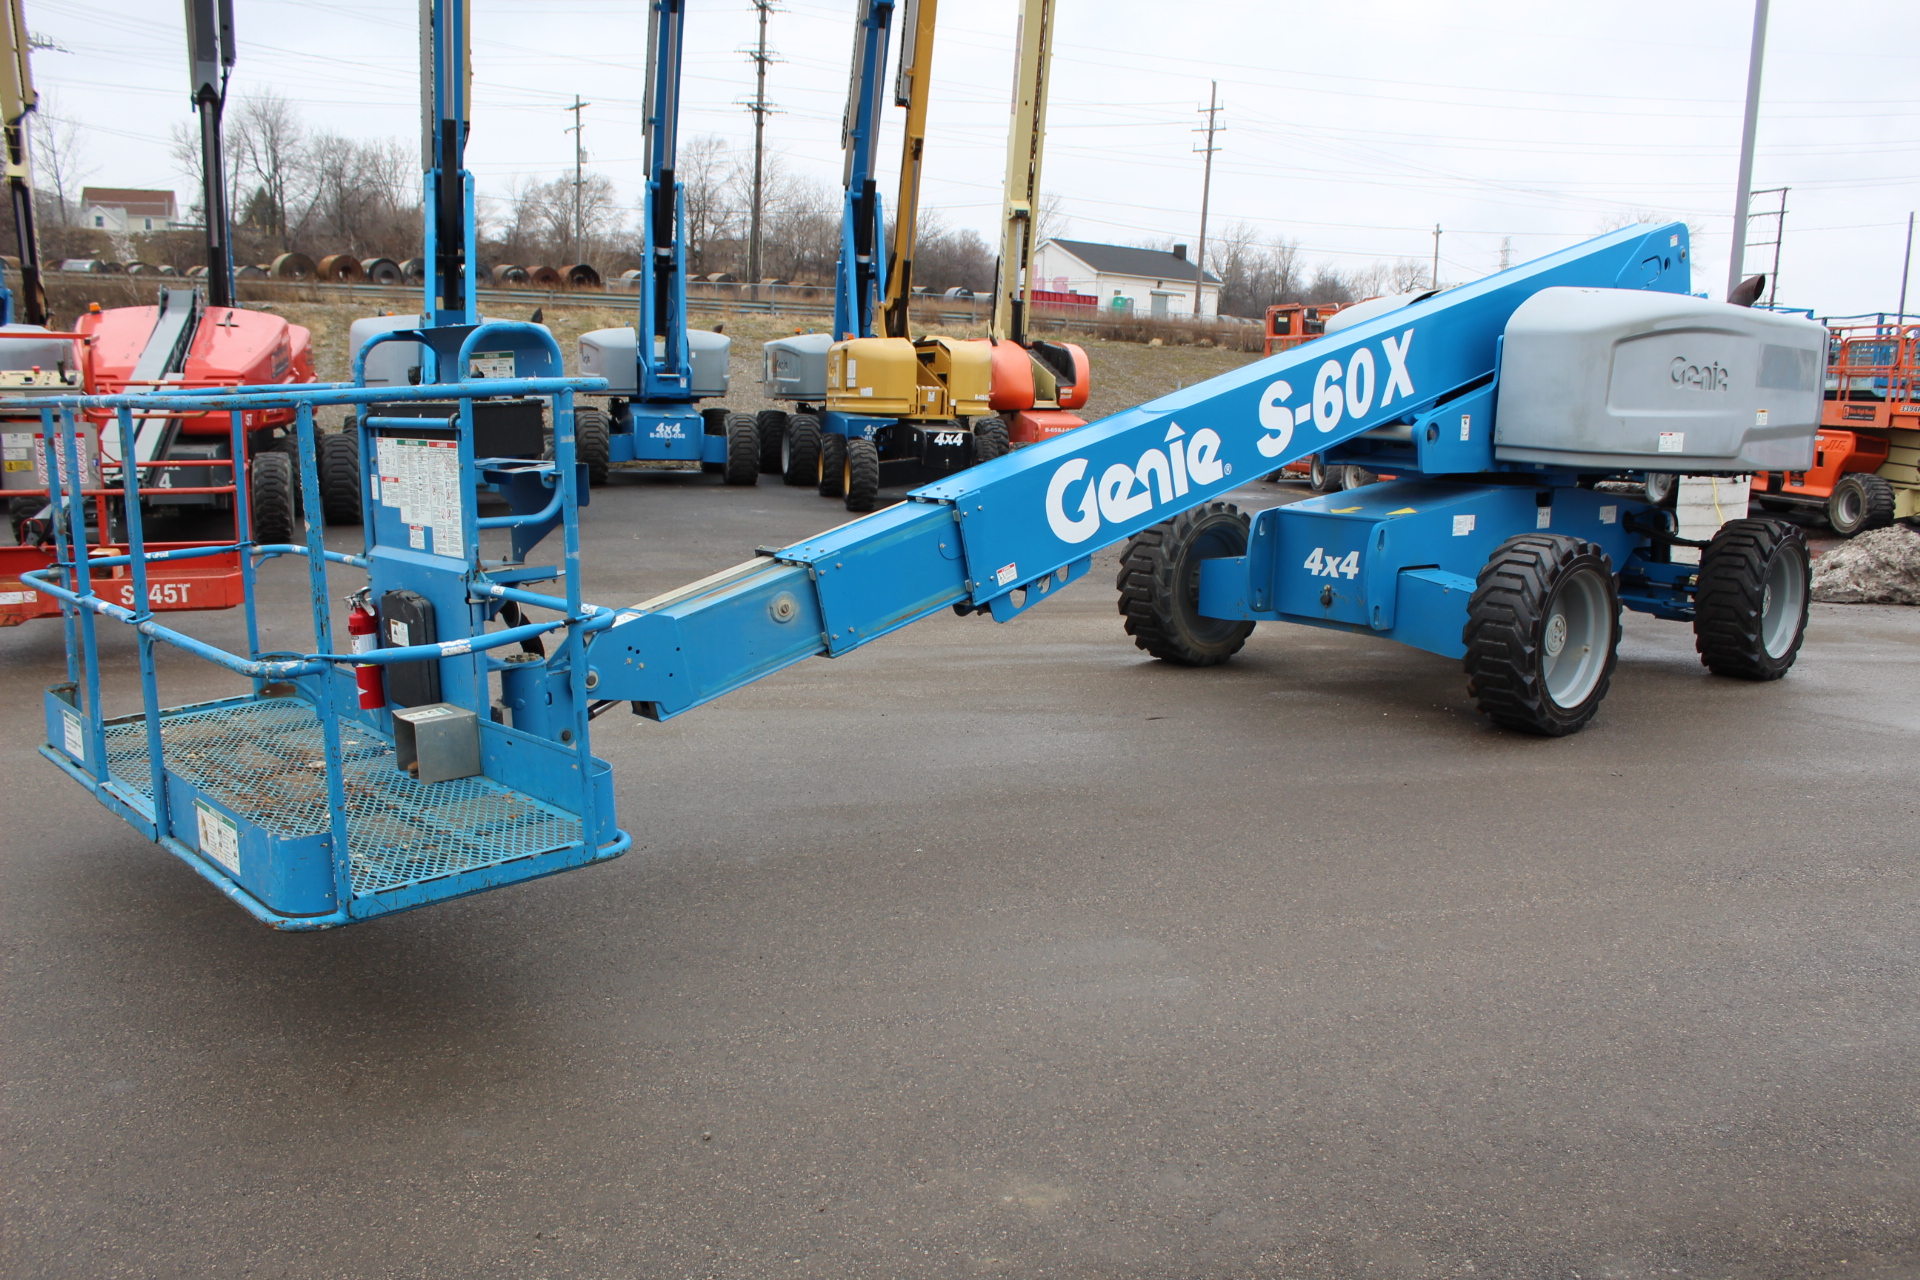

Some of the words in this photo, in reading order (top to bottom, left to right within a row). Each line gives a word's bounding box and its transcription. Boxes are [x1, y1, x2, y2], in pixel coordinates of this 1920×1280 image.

[1669, 356, 1729, 392] Genie
[655, 422, 681, 434] 4x4
[933, 432, 964, 446] 4x4
[1046, 421, 1224, 544] Genie
[1303, 547, 1360, 580] 4x4
